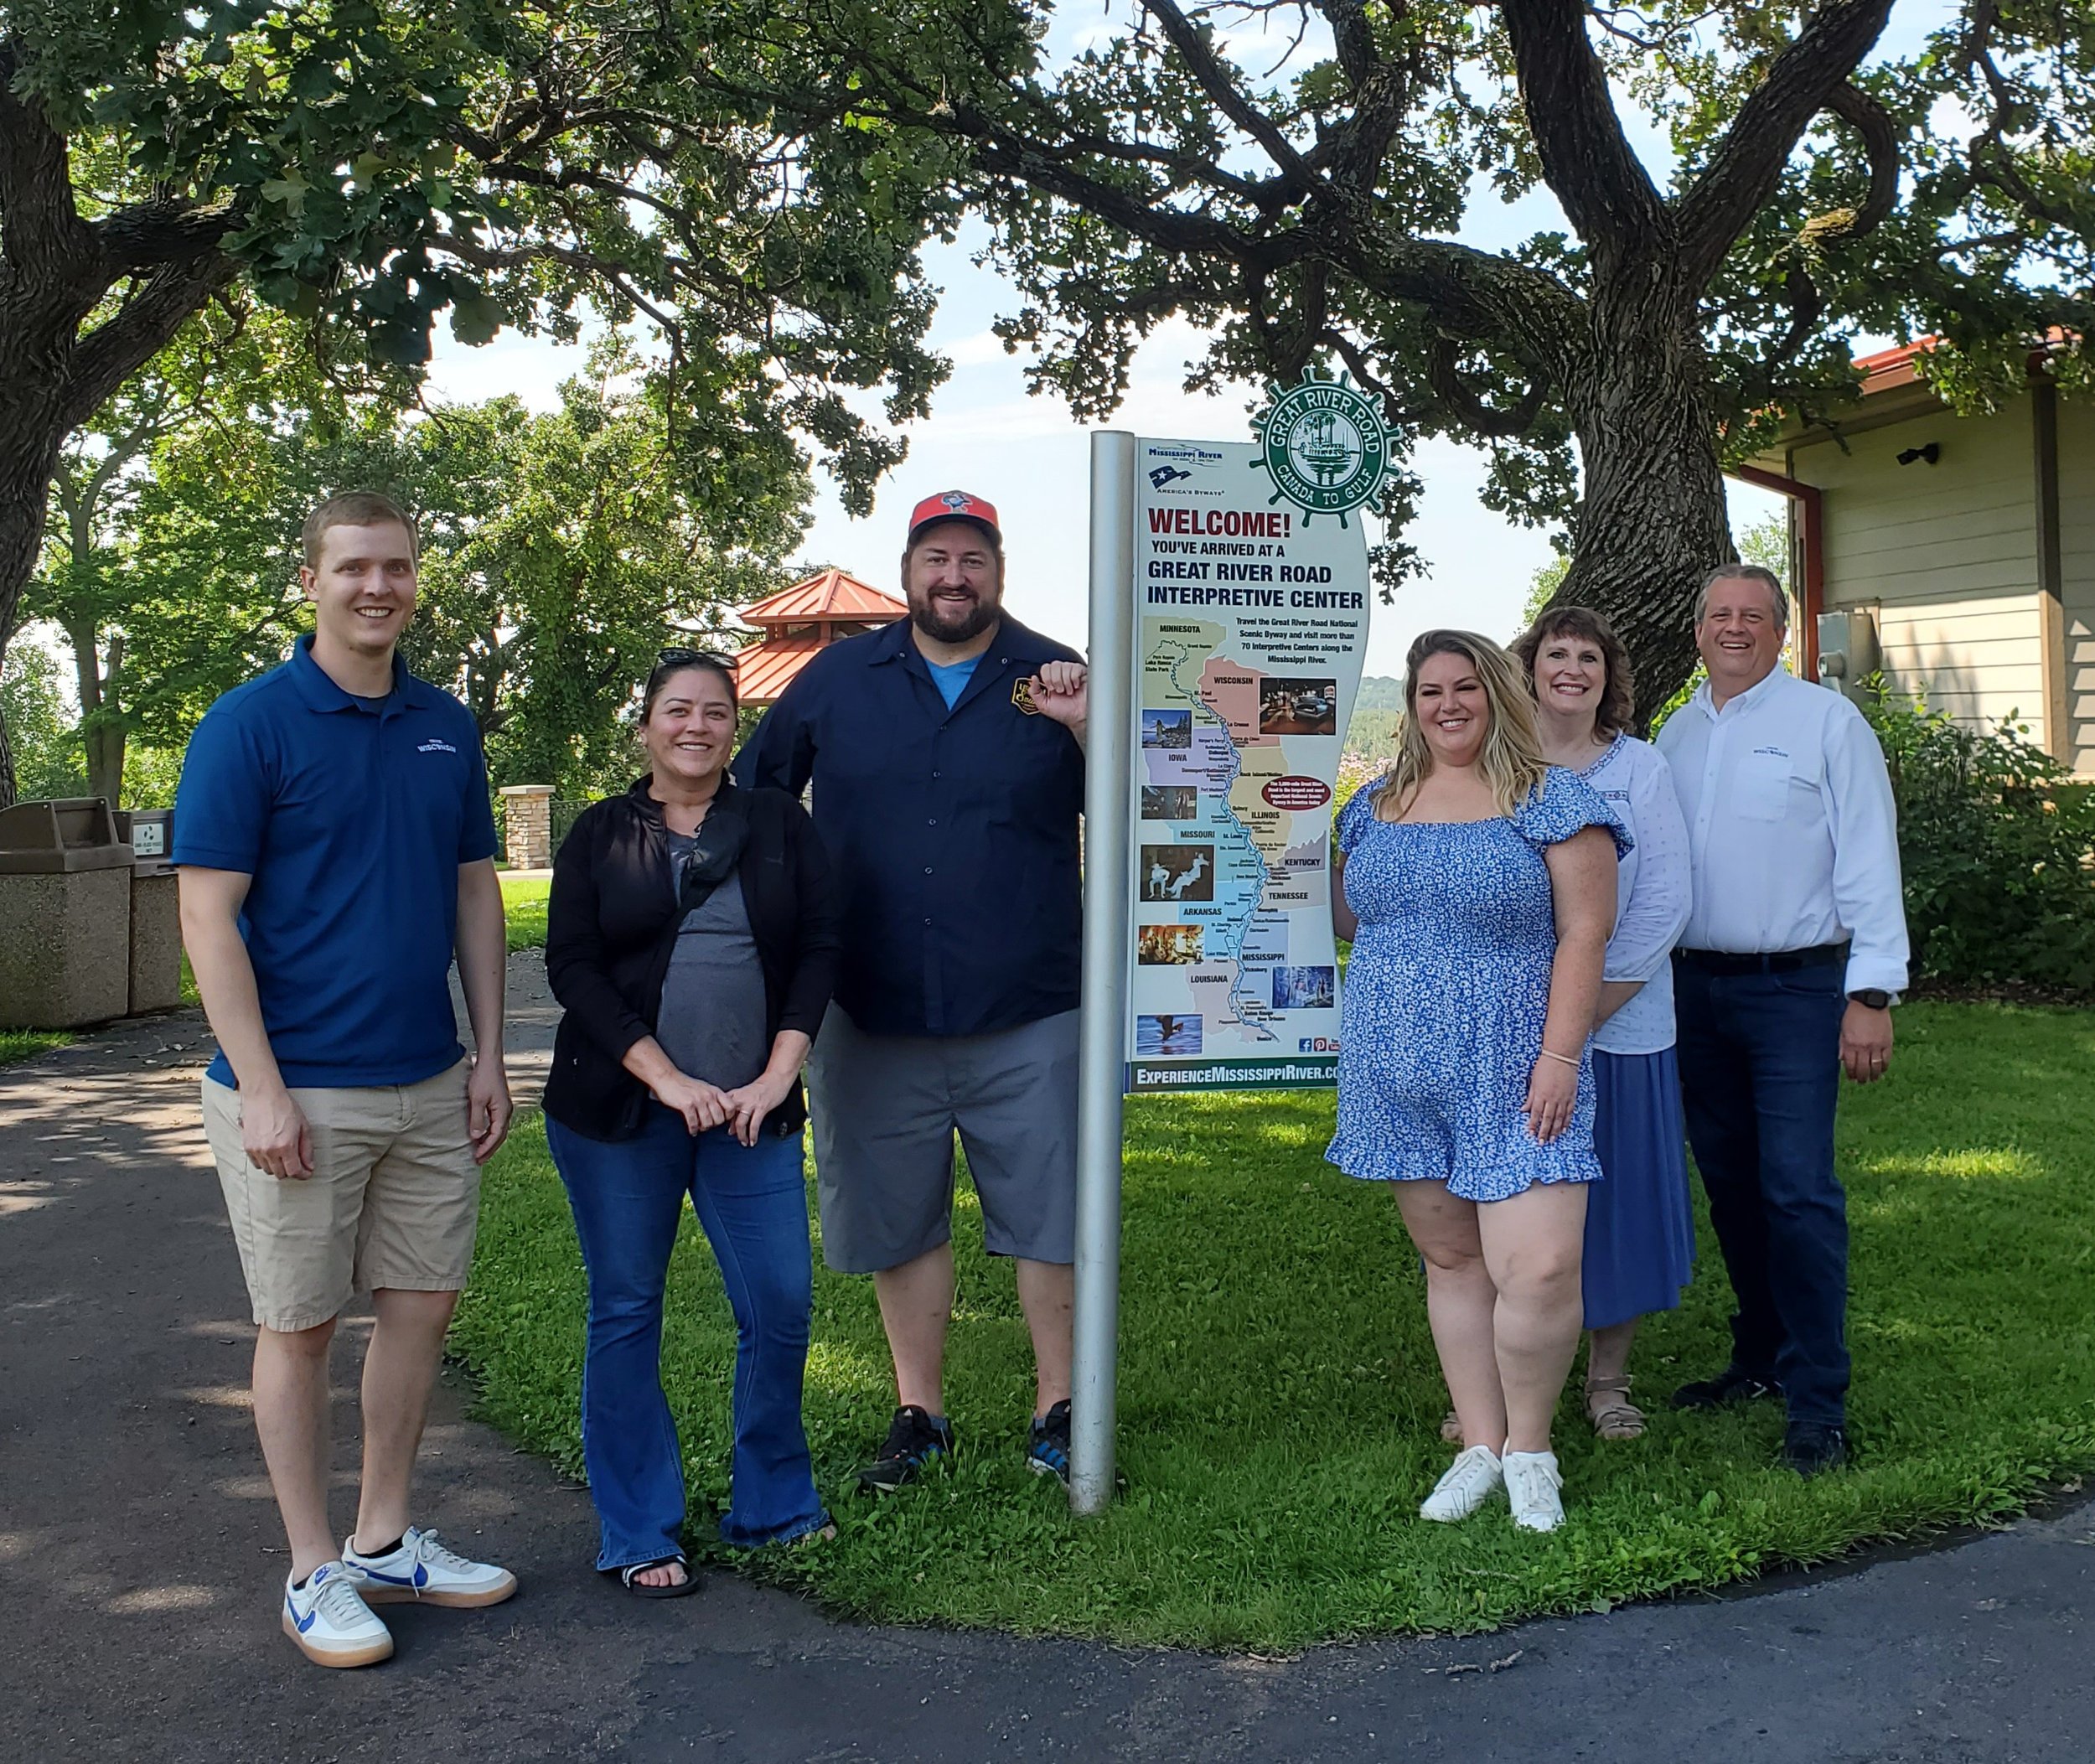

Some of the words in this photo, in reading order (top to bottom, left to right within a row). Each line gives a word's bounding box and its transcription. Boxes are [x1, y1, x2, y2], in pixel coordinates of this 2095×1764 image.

[1271, 398, 1303, 447] GREAT
[1305, 391, 1352, 414] RIVER
[1352, 406, 1379, 453] ROAD
[1277, 465, 1314, 502] CANADA
[1323, 493, 1339, 504] TO
[1345, 468, 1373, 499] GULF
[1148, 508, 1291, 538] WELCOME!
[1151, 541, 1197, 555] YOU'VE
[1200, 542, 1254, 556] ARRIVED
[1258, 544, 1274, 557] AT
[1276, 545, 1285, 557] A
[1148, 561, 1211, 580] GREAT
[1217, 563, 1273, 582] RIVER
[1280, 565, 1332, 583] ROAD
[1147, 586, 1284, 607] INTERPRETIVE
[1291, 591, 1363, 609] CENTER
[1291, 618, 1309, 627] River
[1160, 625, 1201, 634] MINNESOTA
[1265, 631, 1287, 639] Byway
[1304, 631, 1318, 639] visit
[1252, 643, 1291, 652] Interpretive
[1321, 644, 1340, 653] along
[1267, 655, 1306, 665] Mississippi
[1284, 858, 1321, 866] KENTUCKY
[1269, 892, 1308, 900] TENNESSEE
[1191, 975, 1228, 983] LOUISIANA
[1137, 1064, 1338, 1084] EXPERIENCEMISSISSIPPIRIVER.CO
